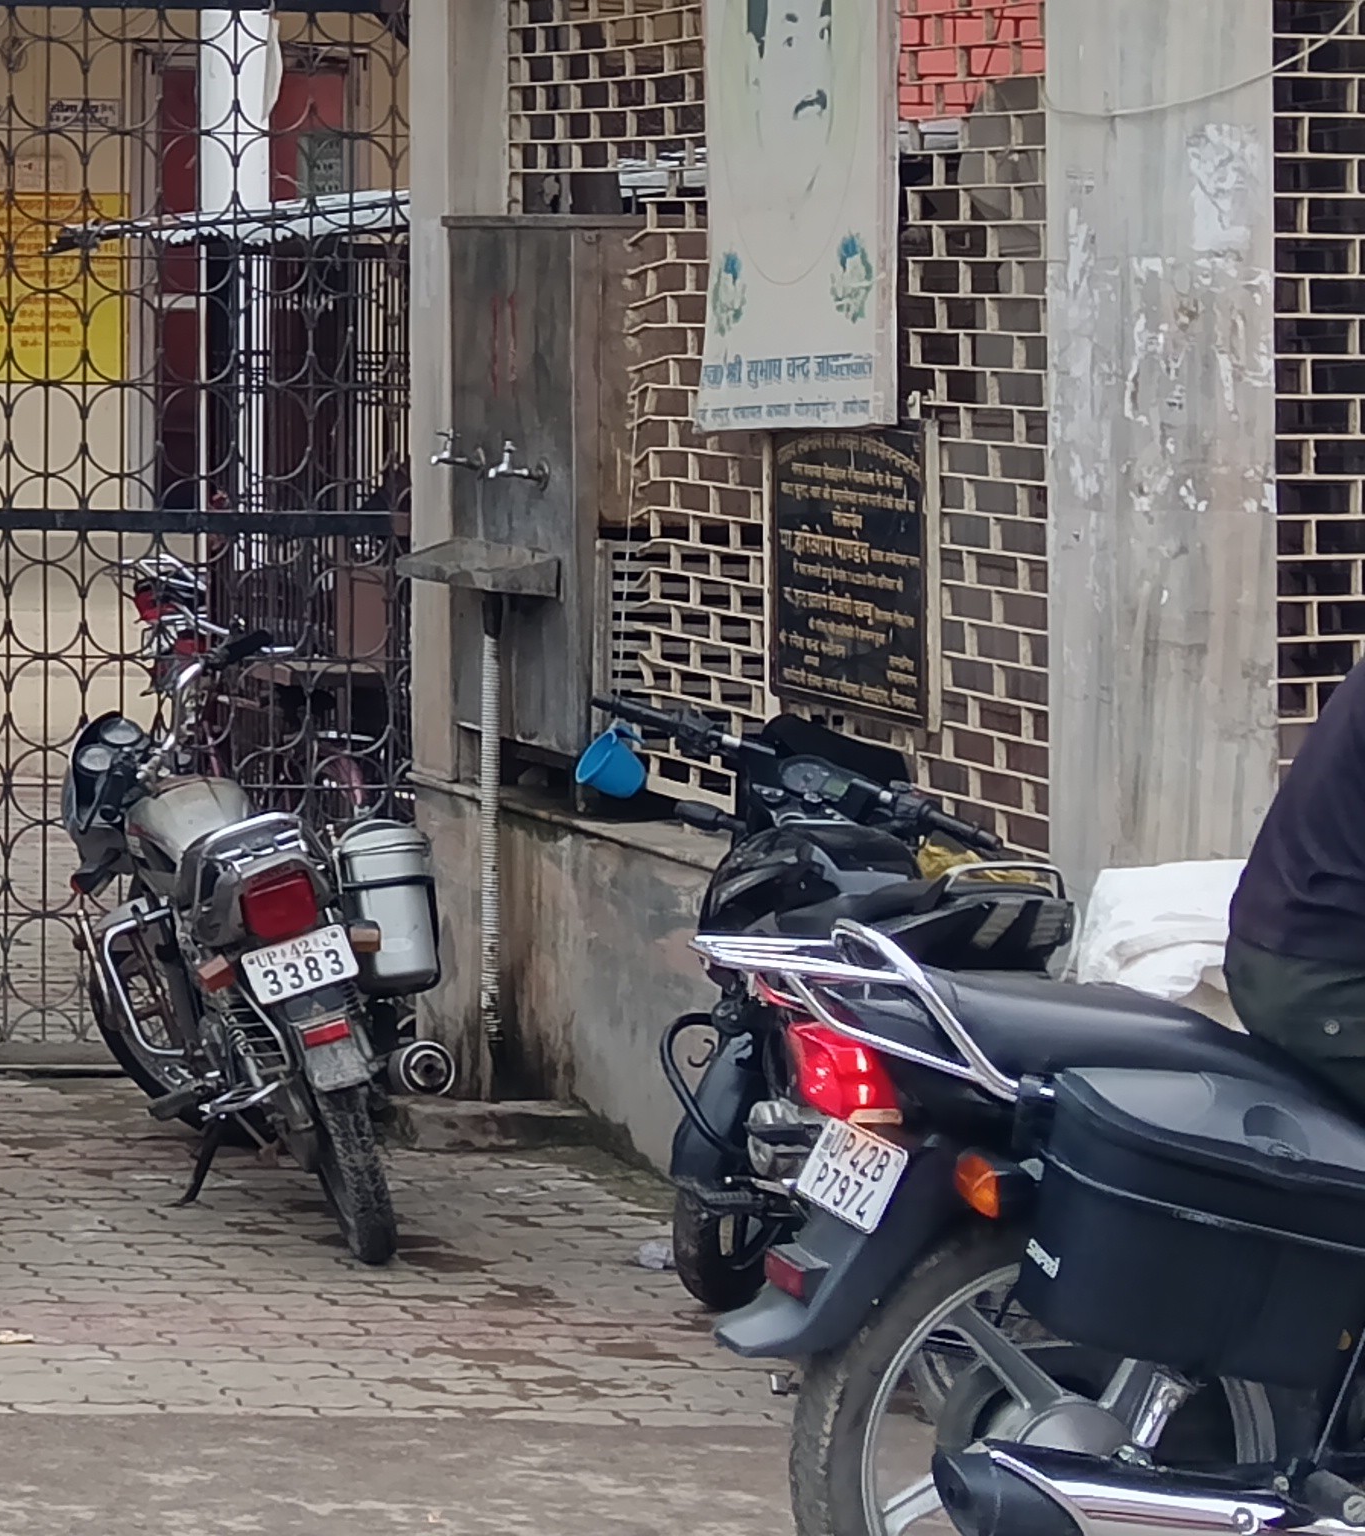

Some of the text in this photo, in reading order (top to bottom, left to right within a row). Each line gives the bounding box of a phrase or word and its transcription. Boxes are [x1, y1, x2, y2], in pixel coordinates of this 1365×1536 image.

[262, 949, 345, 996] 3383
[829, 1128, 891, 1182] UP42B
[810, 1162, 875, 1222] P7974
